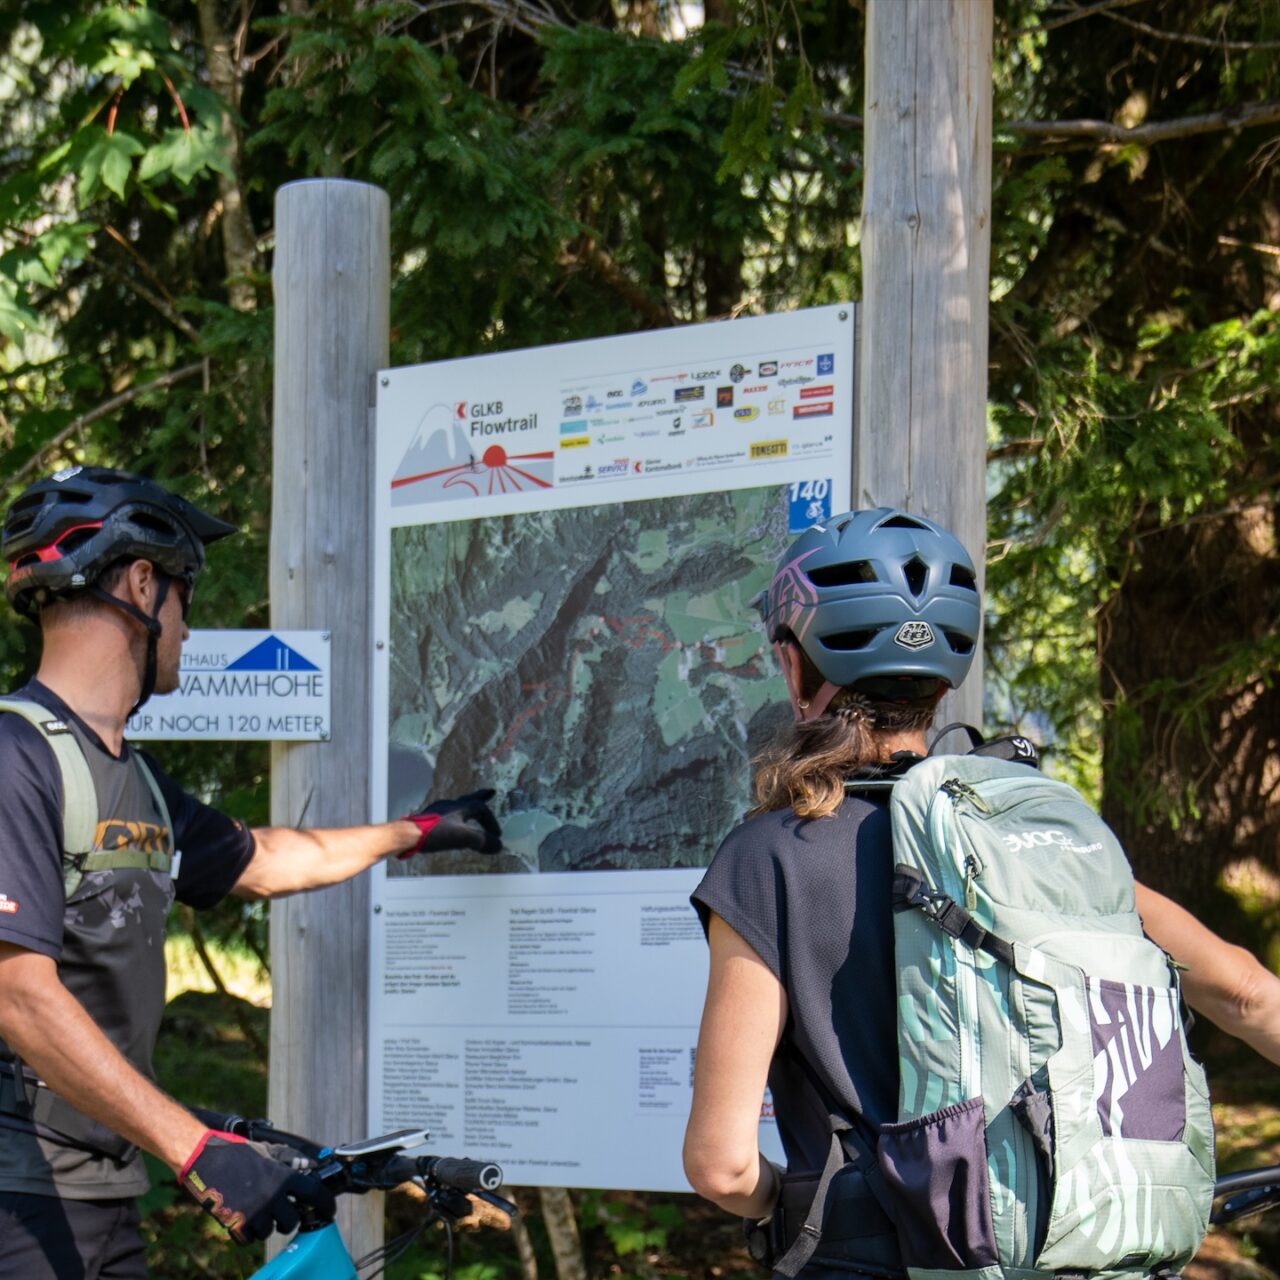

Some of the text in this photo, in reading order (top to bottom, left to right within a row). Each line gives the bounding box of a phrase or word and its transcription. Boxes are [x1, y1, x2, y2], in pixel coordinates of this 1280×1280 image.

[471, 401, 503, 418] GLKB
[471, 413, 538, 437] Flowtrail
[789, 480, 828, 502] 140
[182, 653, 229, 667] THAUS
[127, 715, 324, 732] UR NOCH 120 METER
